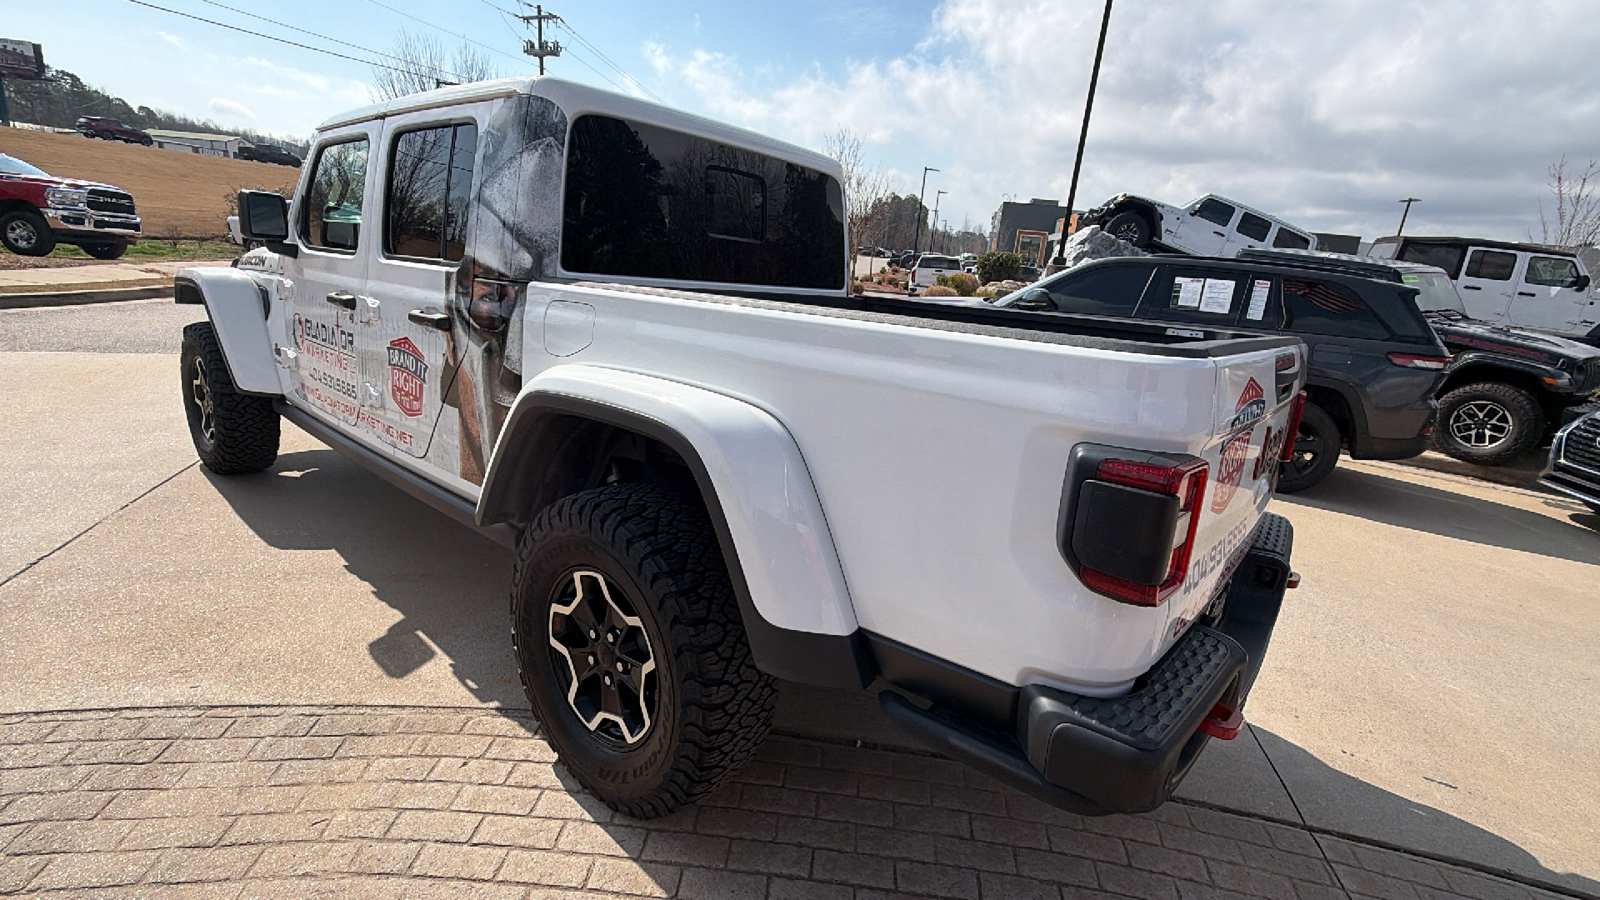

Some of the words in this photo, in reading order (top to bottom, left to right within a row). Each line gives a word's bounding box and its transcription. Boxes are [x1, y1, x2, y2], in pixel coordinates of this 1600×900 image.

[304, 315, 355, 354] GLADIATOR
[306, 343, 348, 371] MARKETING
[389, 348, 416, 373] BRAND
[416, 361, 427, 380] IT
[393, 369, 421, 398] RIGHT
